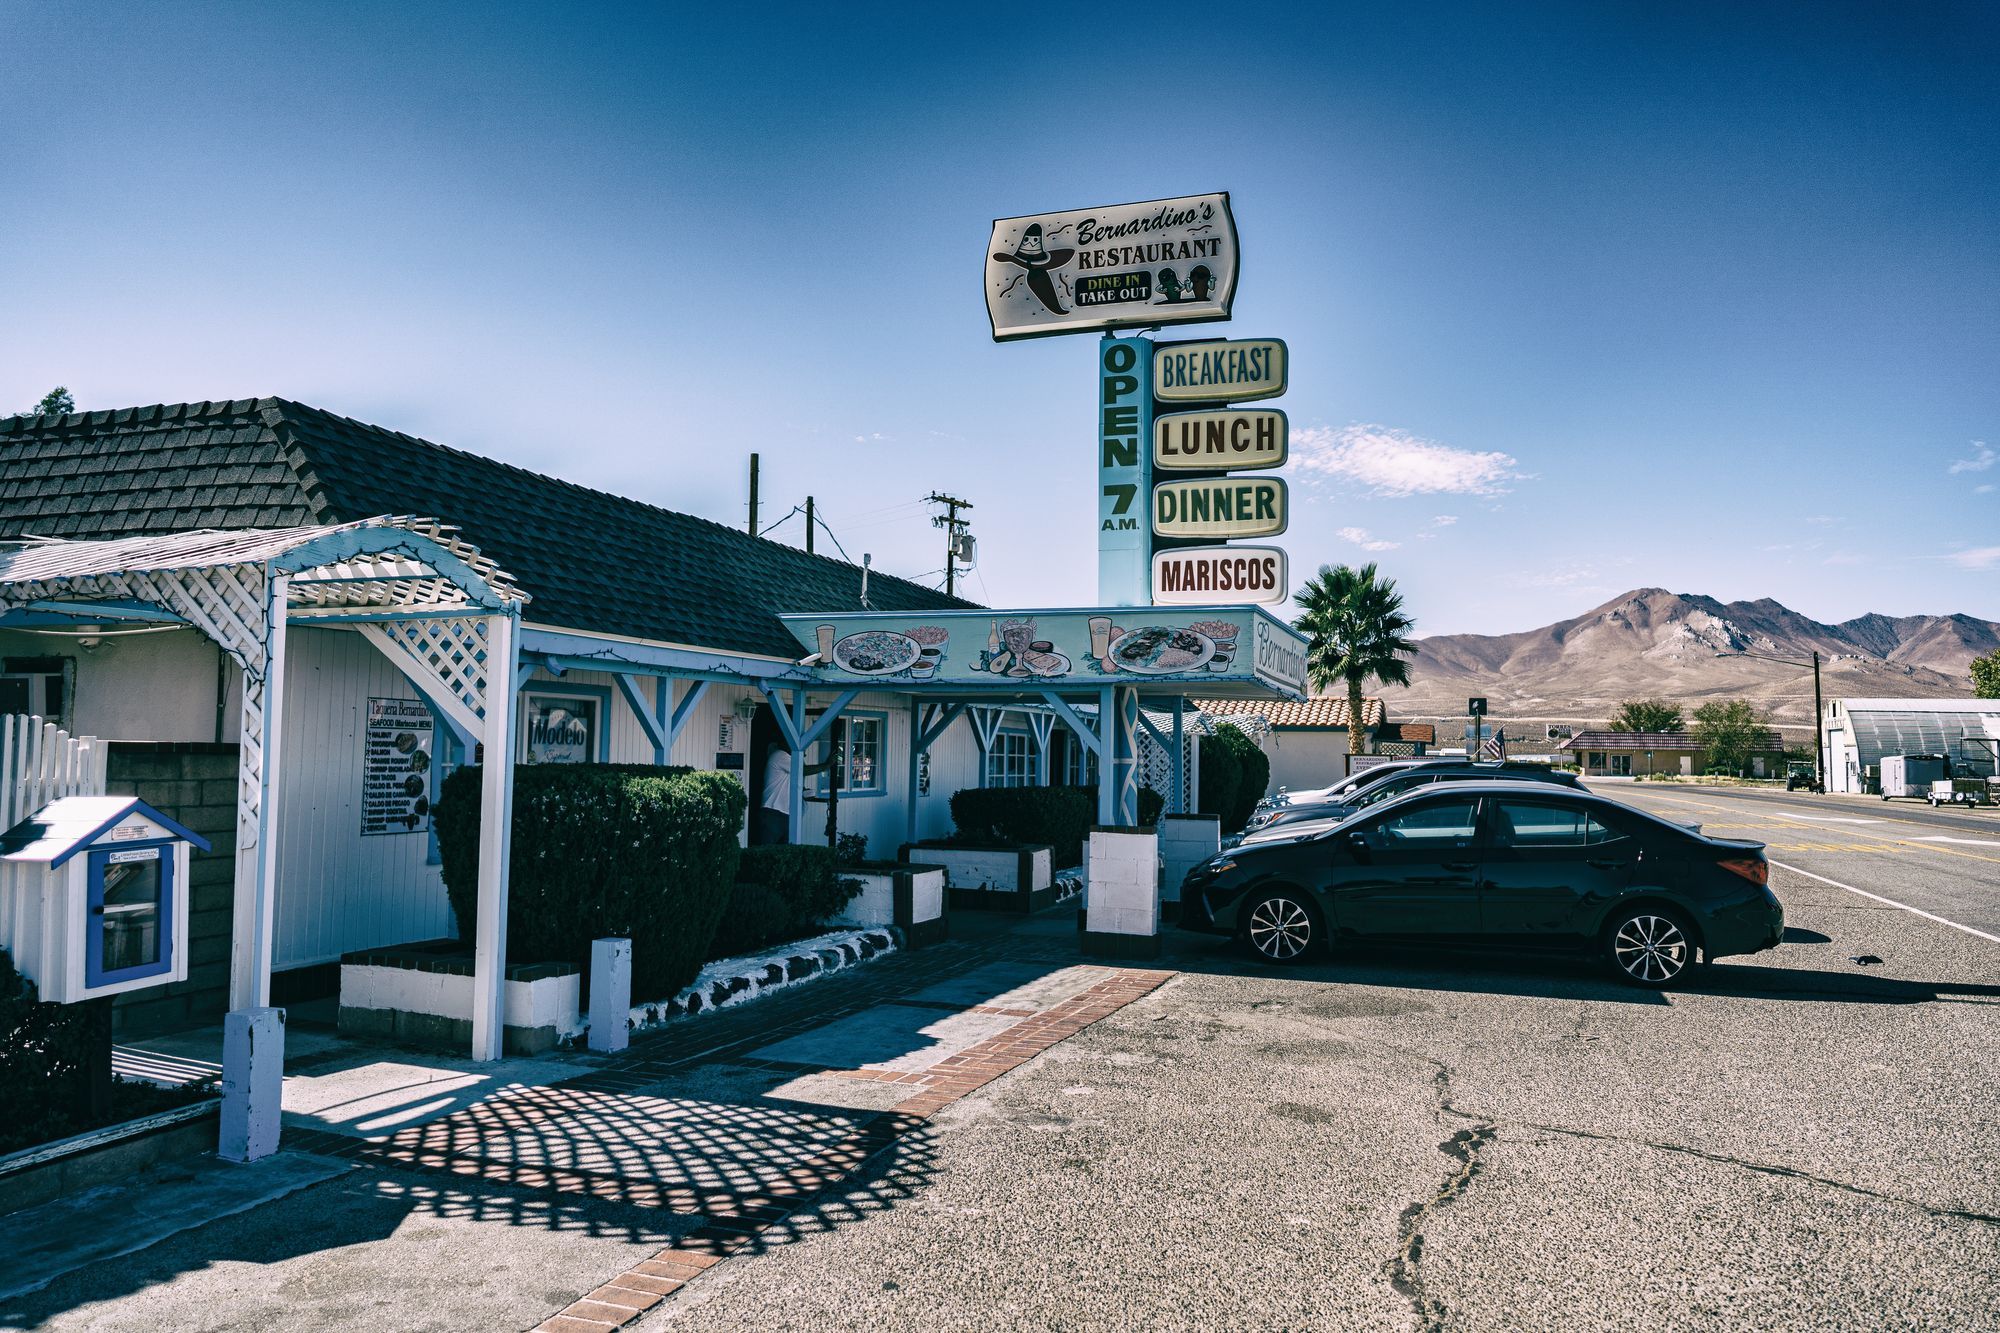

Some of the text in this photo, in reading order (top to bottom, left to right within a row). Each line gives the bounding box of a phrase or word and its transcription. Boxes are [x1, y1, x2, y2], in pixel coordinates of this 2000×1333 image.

[1076, 202, 1215, 246] Bernardino's
[1078, 238, 1222, 270] RESTAURANT
[1079, 286, 1148, 304] TAKE OUT
[1088, 273, 1140, 291] DINE IN
[1163, 347, 1273, 388] BREAKFAST
[1101, 344, 1140, 531] OPEN 7 A.M.
[1162, 417, 1275, 456] LUNCH
[1158, 486, 1276, 524] DINNER
[1161, 557, 1276, 592] MARISCOS
[369, 718, 395, 727] SEAFOOD
[418, 720, 432, 728] MENU
[533, 718, 585, 746] Modelo
